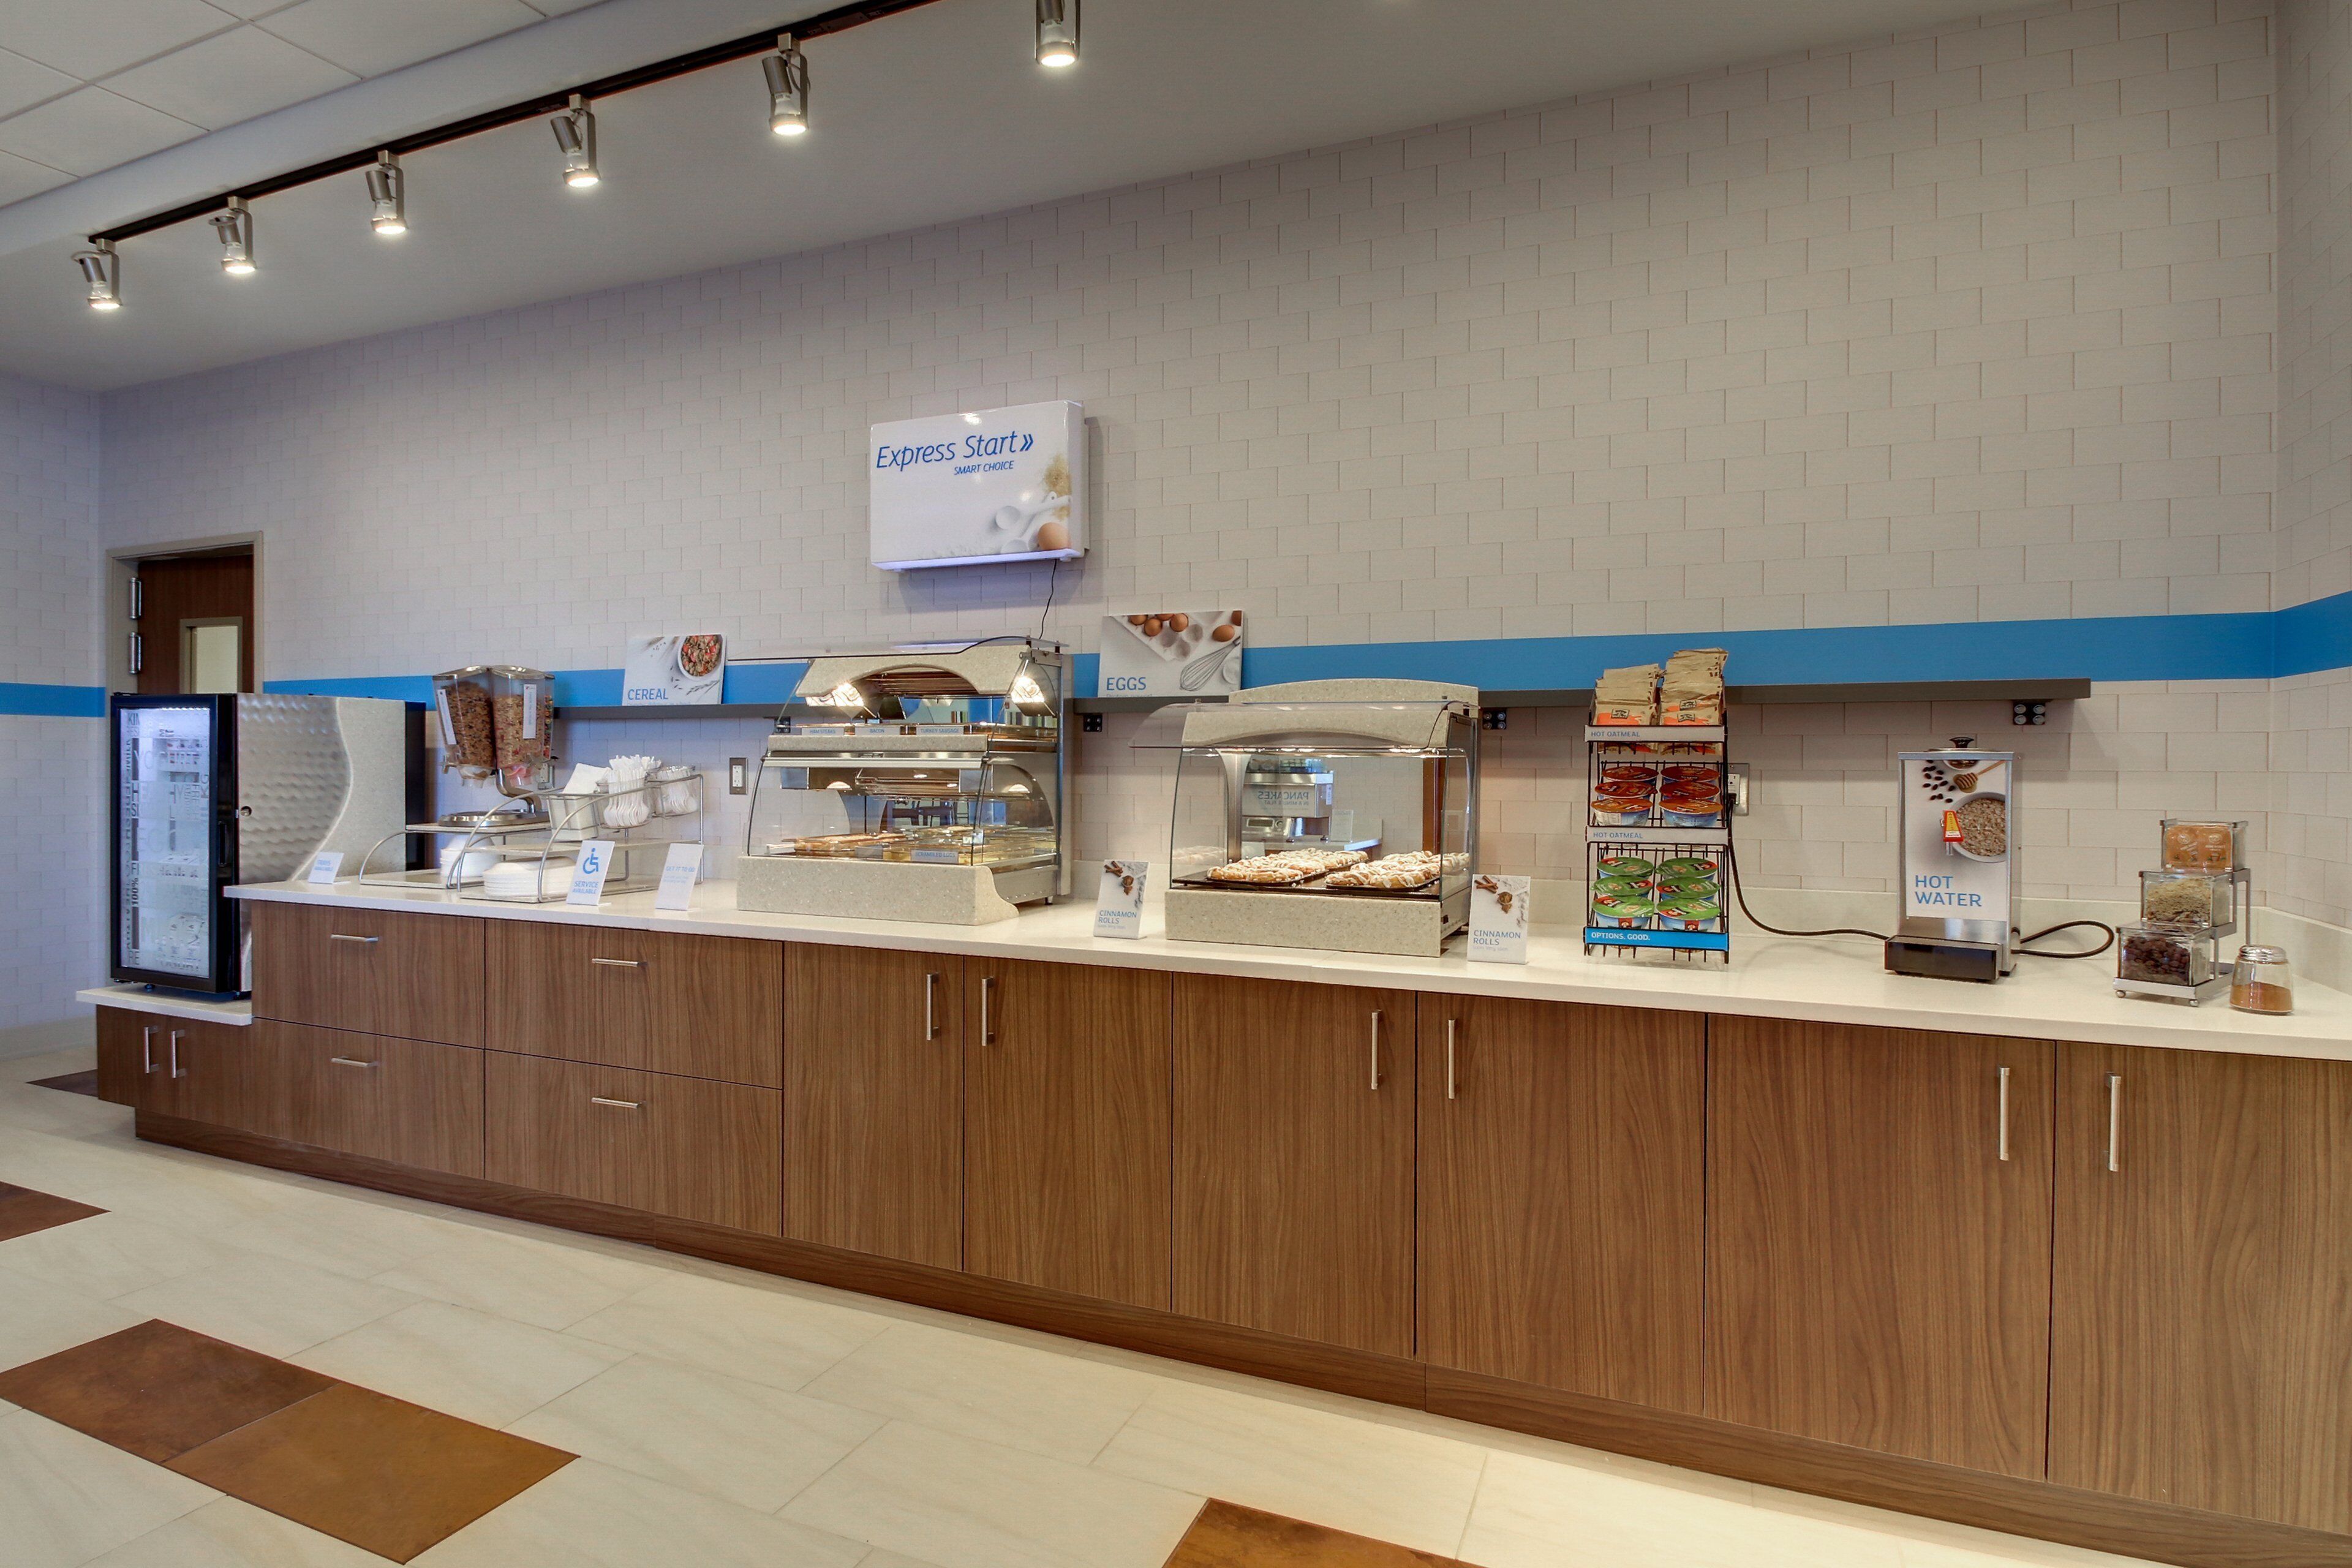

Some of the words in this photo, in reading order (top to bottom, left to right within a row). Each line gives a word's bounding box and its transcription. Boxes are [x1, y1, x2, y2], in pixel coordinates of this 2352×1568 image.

[876, 442, 956, 472] Express
[963, 431, 1017, 458] Start
[954, 464, 980, 475] SMART
[983, 461, 1014, 472] CHOICE
[1106, 676, 1147, 691] EGGS
[627, 688, 668, 700] CEREAL
[1915, 875, 1954, 889] HOT
[1915, 891, 1982, 907] WATER
[1474, 930, 1521, 938] CINNAMON
